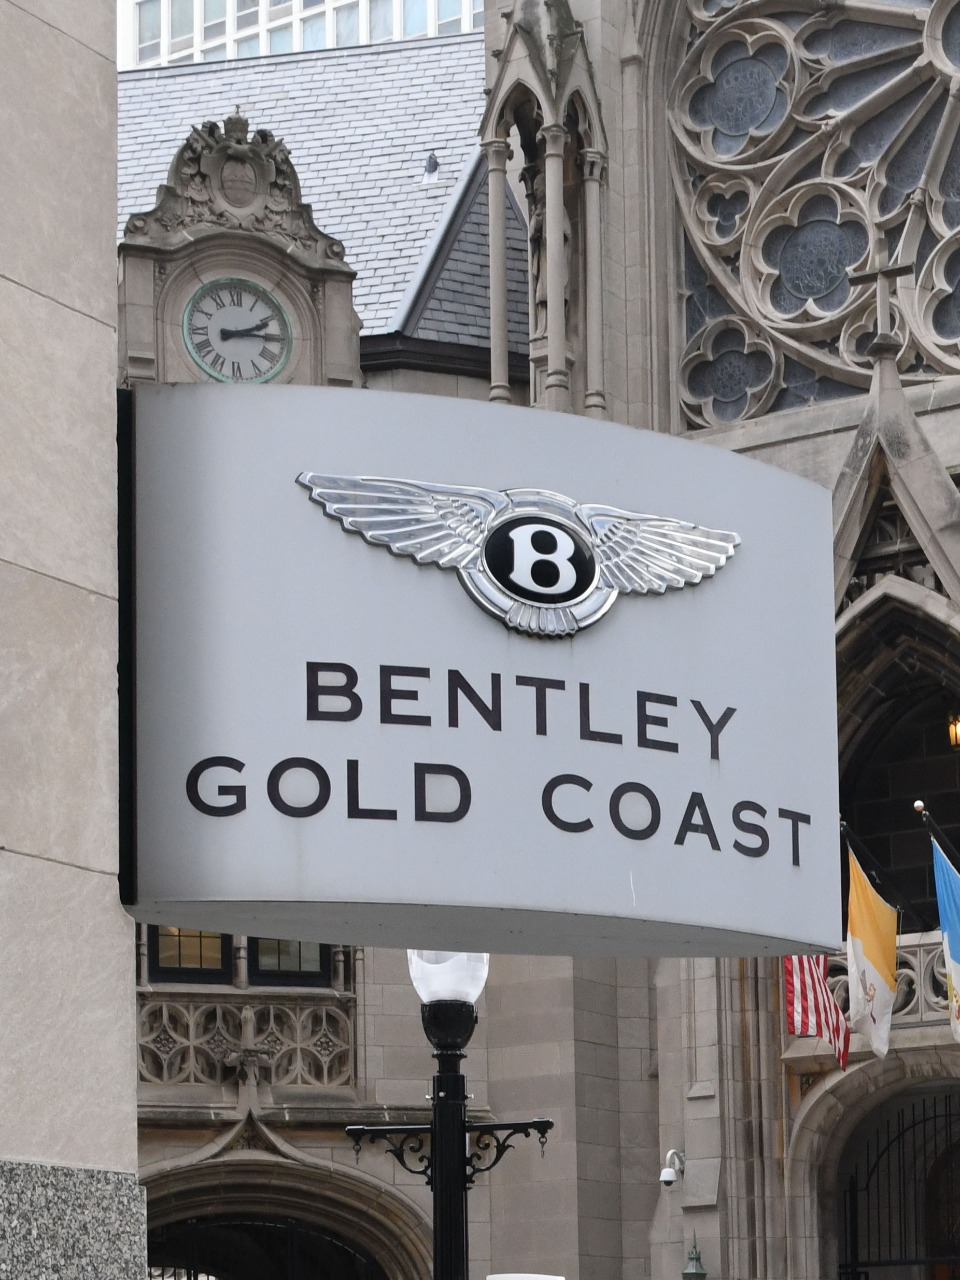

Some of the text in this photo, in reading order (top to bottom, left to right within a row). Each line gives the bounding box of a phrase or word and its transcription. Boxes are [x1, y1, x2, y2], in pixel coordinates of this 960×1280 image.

[210, 289, 226, 311] XI
[229, 287, 243, 307] XII
[191, 325, 209, 336] IX
[210, 352, 226, 373] VII
[231, 361, 244, 380] VI
[509, 523, 577, 595] B
[306, 661, 737, 760] BENTLEY
[186, 756, 811, 866] GOLD COAST
